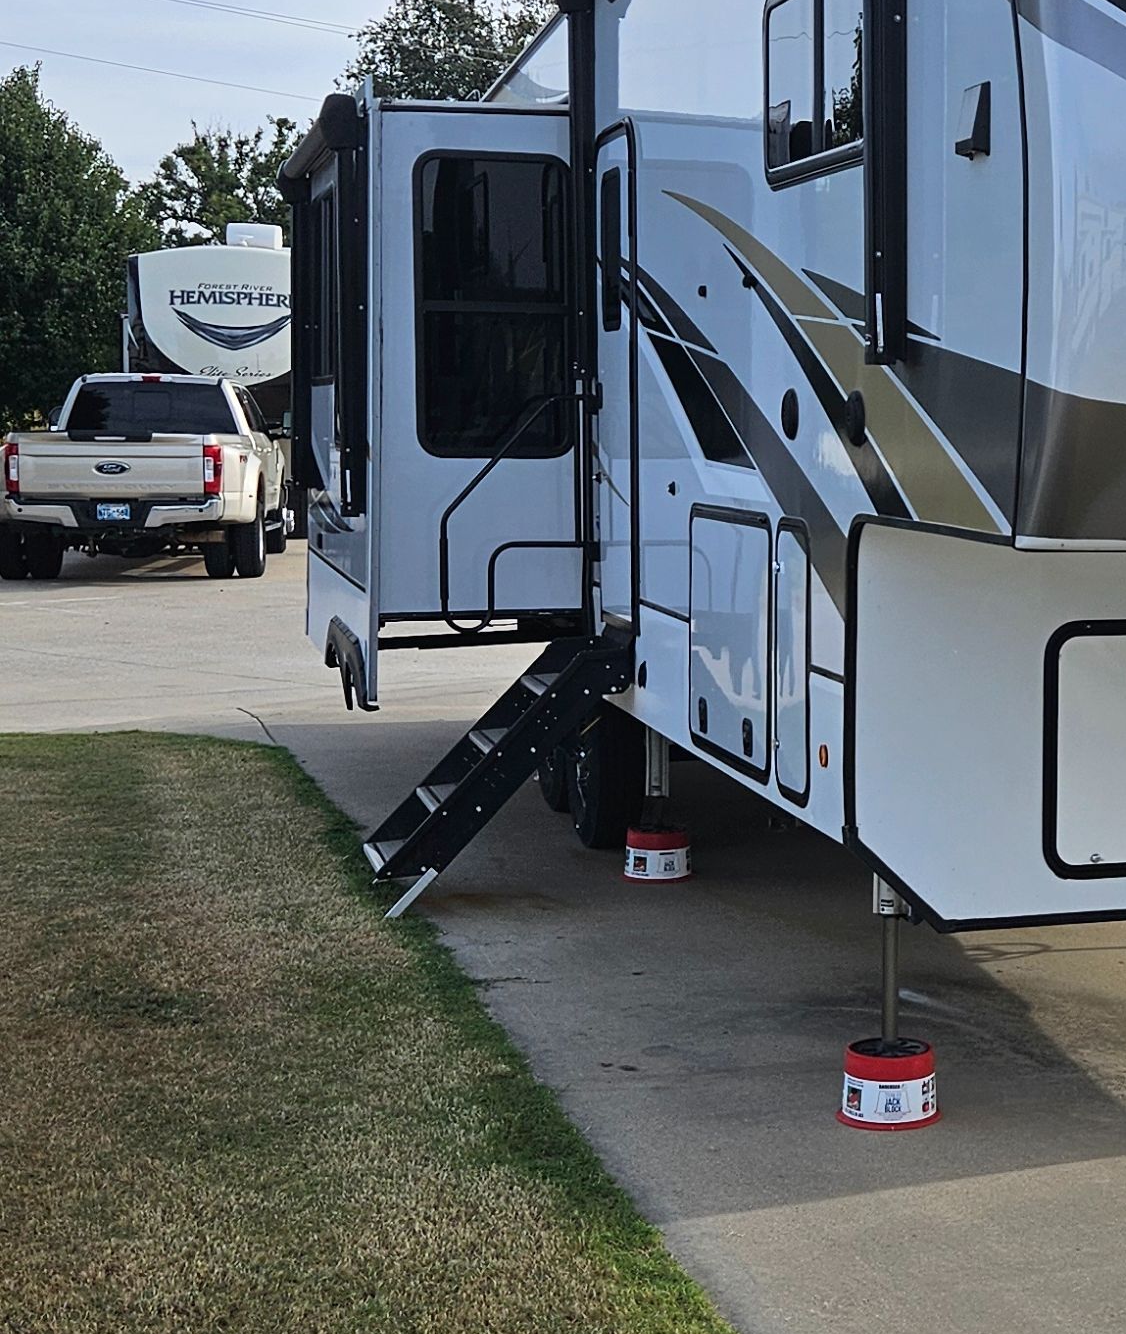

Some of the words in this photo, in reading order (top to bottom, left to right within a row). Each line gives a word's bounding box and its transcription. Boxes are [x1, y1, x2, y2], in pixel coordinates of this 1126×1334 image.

[198, 282, 239, 291] FOREST
[241, 284, 273, 292] RIVER
[169, 290, 291, 308] HEMISPHER
[199, 366, 228, 378] Elite
[235, 366, 272, 378] Series
